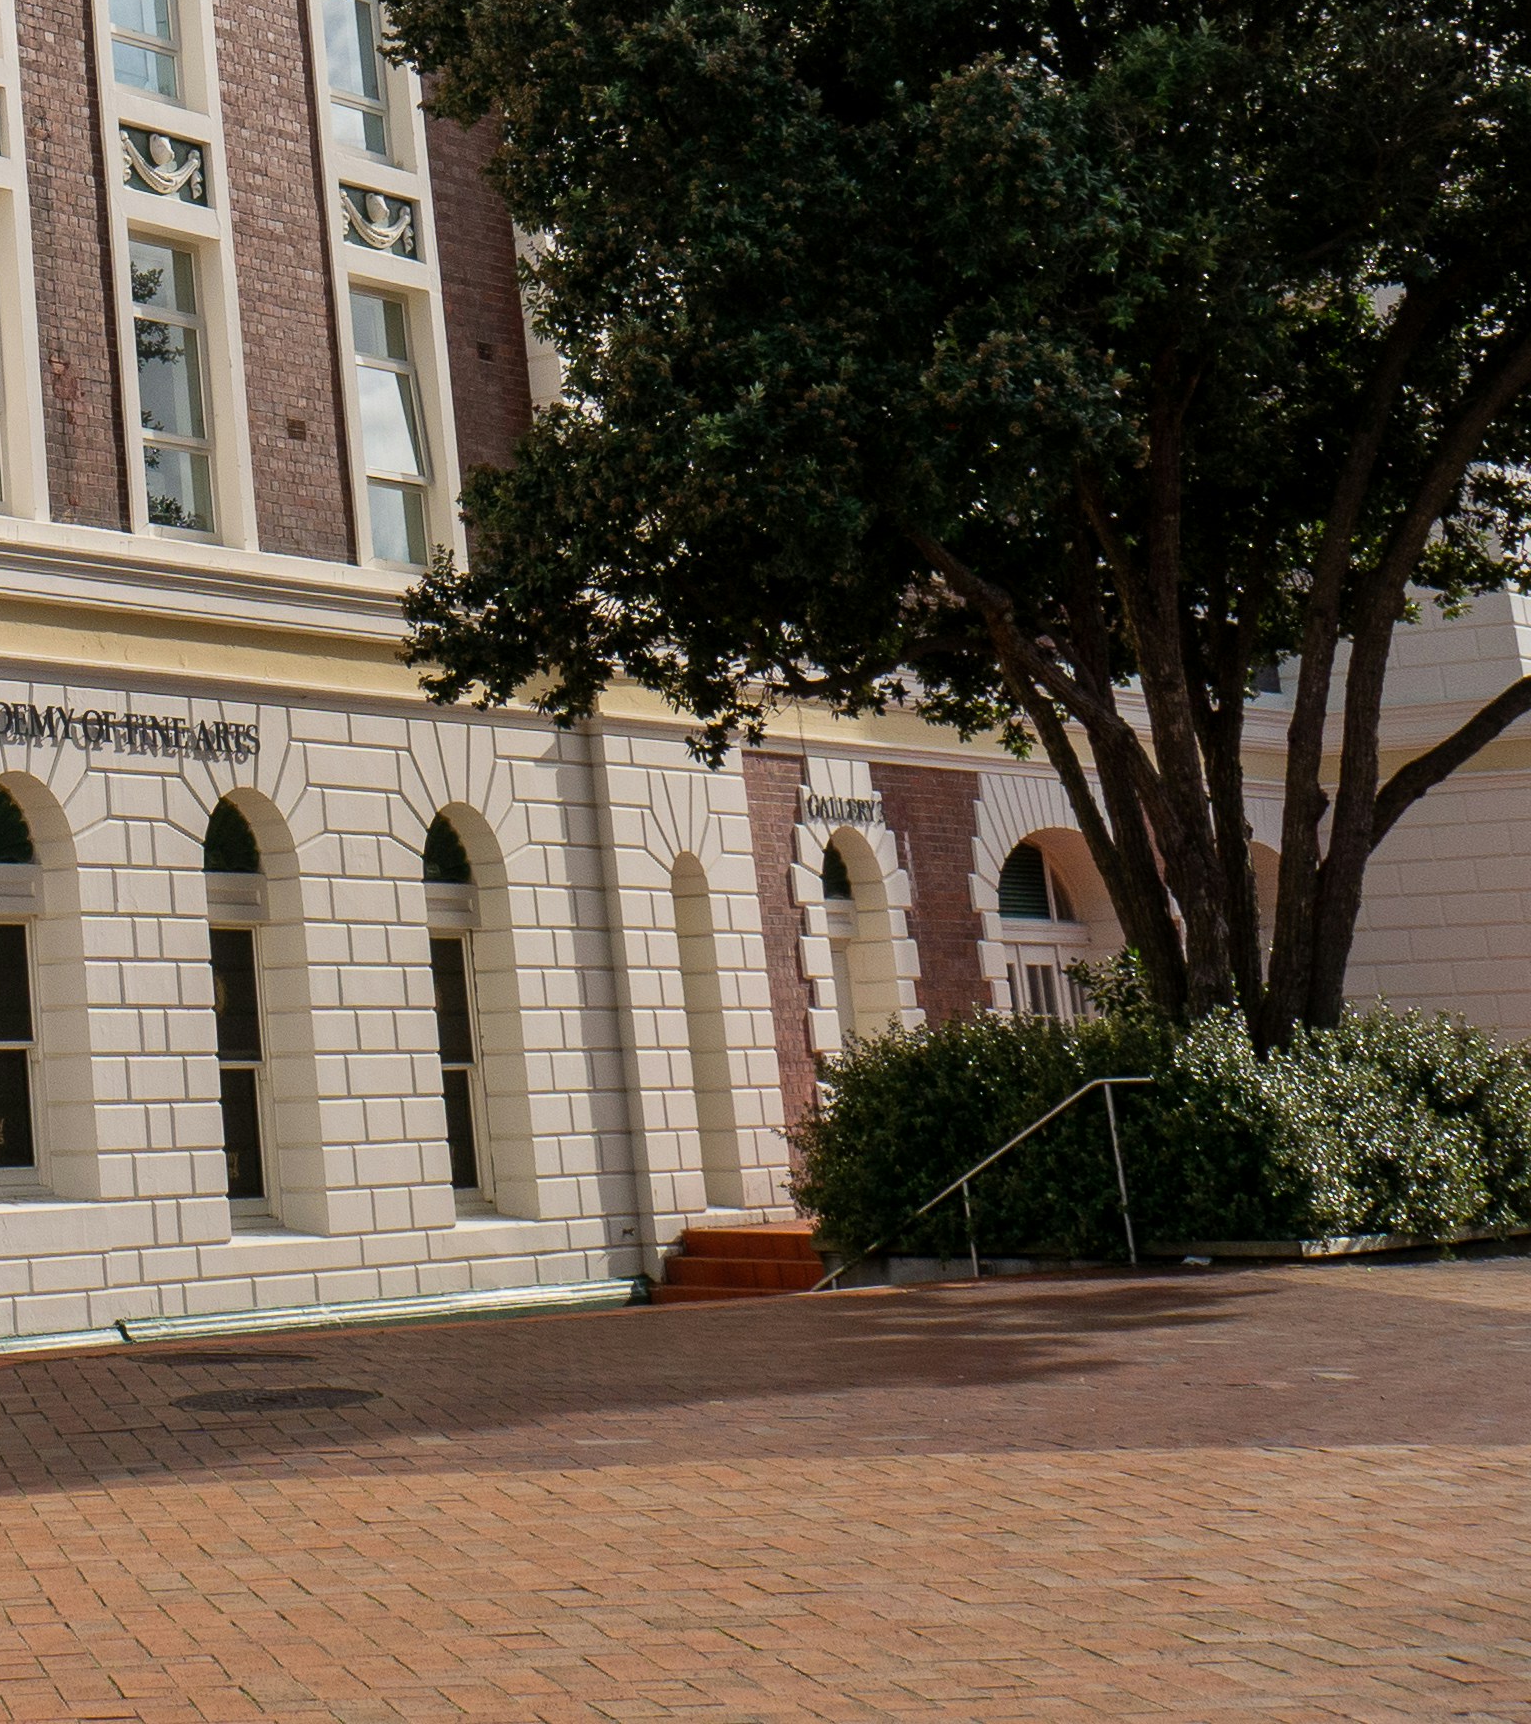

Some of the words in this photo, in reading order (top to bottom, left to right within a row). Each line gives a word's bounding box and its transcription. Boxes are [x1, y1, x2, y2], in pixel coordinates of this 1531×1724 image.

[82, 709, 116, 744] OF
[123, 712, 187, 748] FINE
[194, 719, 262, 756] ARTS
[807, 794, 875, 822] GALLERY
